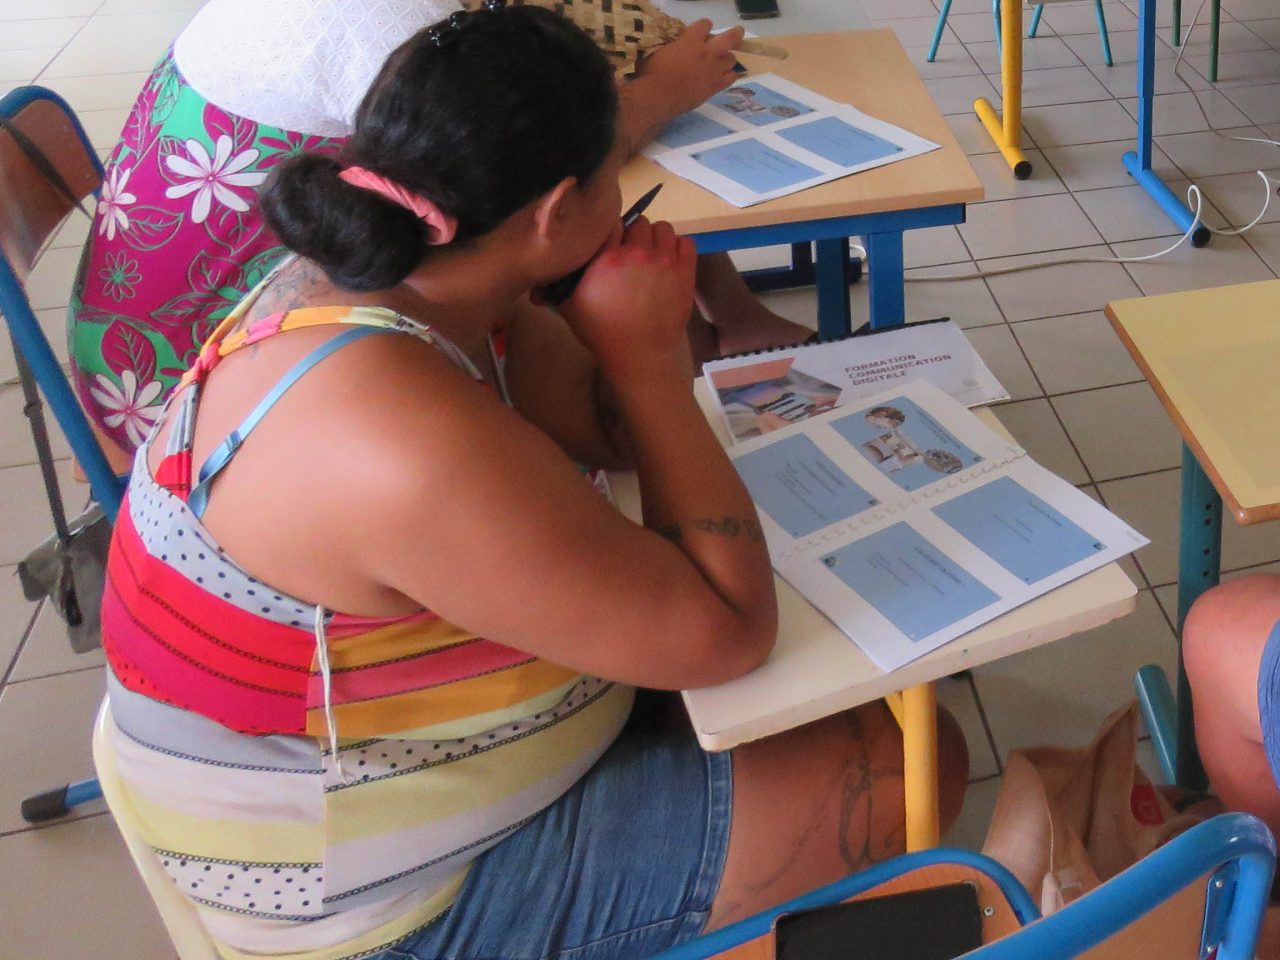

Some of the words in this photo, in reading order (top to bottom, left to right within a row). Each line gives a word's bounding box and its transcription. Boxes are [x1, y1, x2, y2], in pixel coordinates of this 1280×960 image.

[845, 353, 916, 373] FORMATION
[848, 354, 952, 379] COMMUNICATION
[852, 370, 907, 386] DIGITALE
